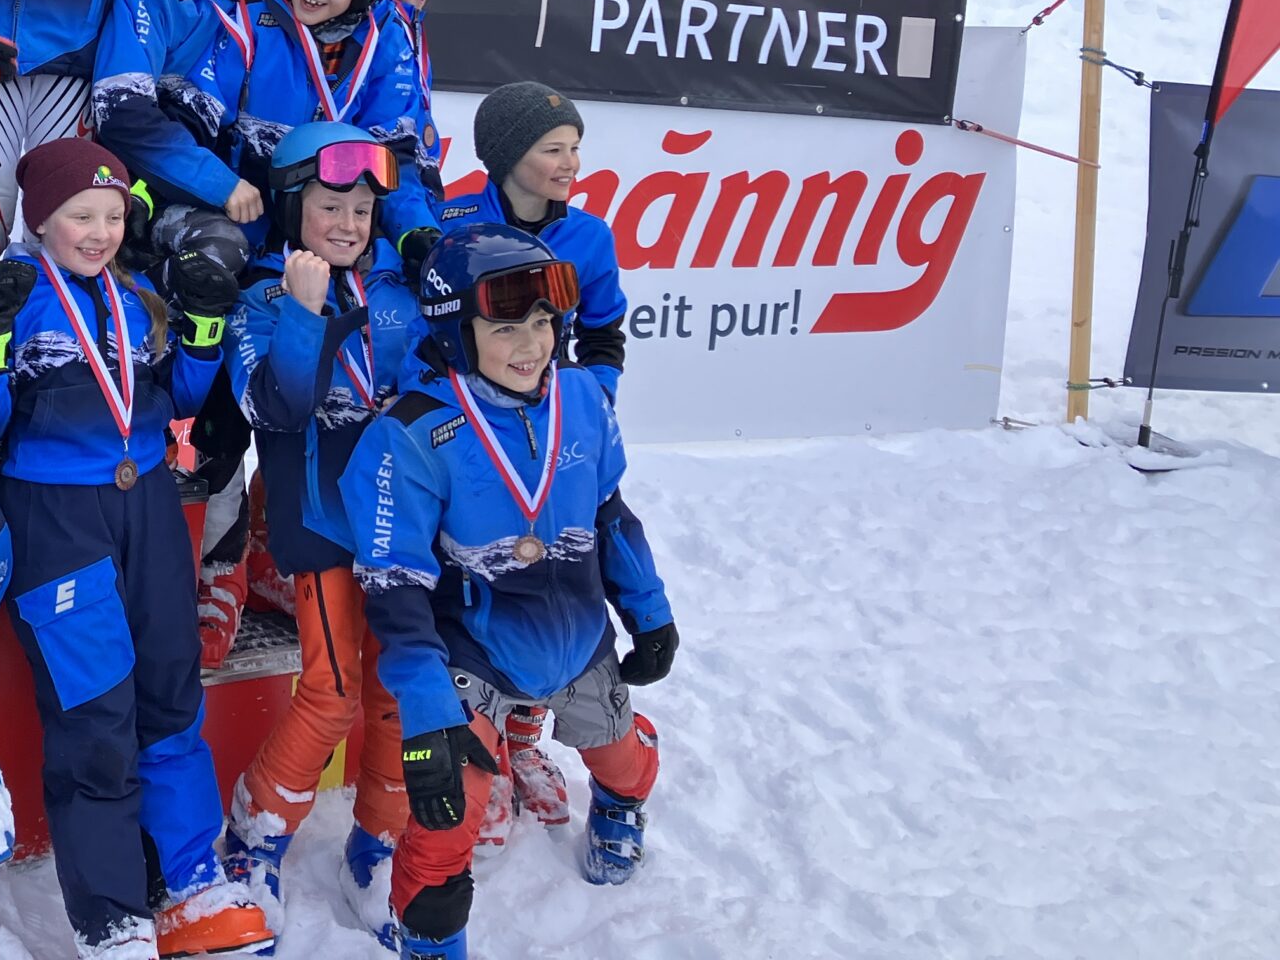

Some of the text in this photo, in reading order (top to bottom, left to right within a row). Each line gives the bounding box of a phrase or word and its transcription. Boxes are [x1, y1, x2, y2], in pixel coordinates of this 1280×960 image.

[433, 298, 461, 316] GIRO
[374, 309, 403, 327] SSC
[707, 289, 802, 351] pur!
[1173, 345, 1263, 359] PASSION
[432, 415, 466, 439] ENERGIA
[432, 430, 455, 447] PURA
[371, 452, 395, 559] RAIFFEISEN
[403, 749, 433, 762] LEKI
